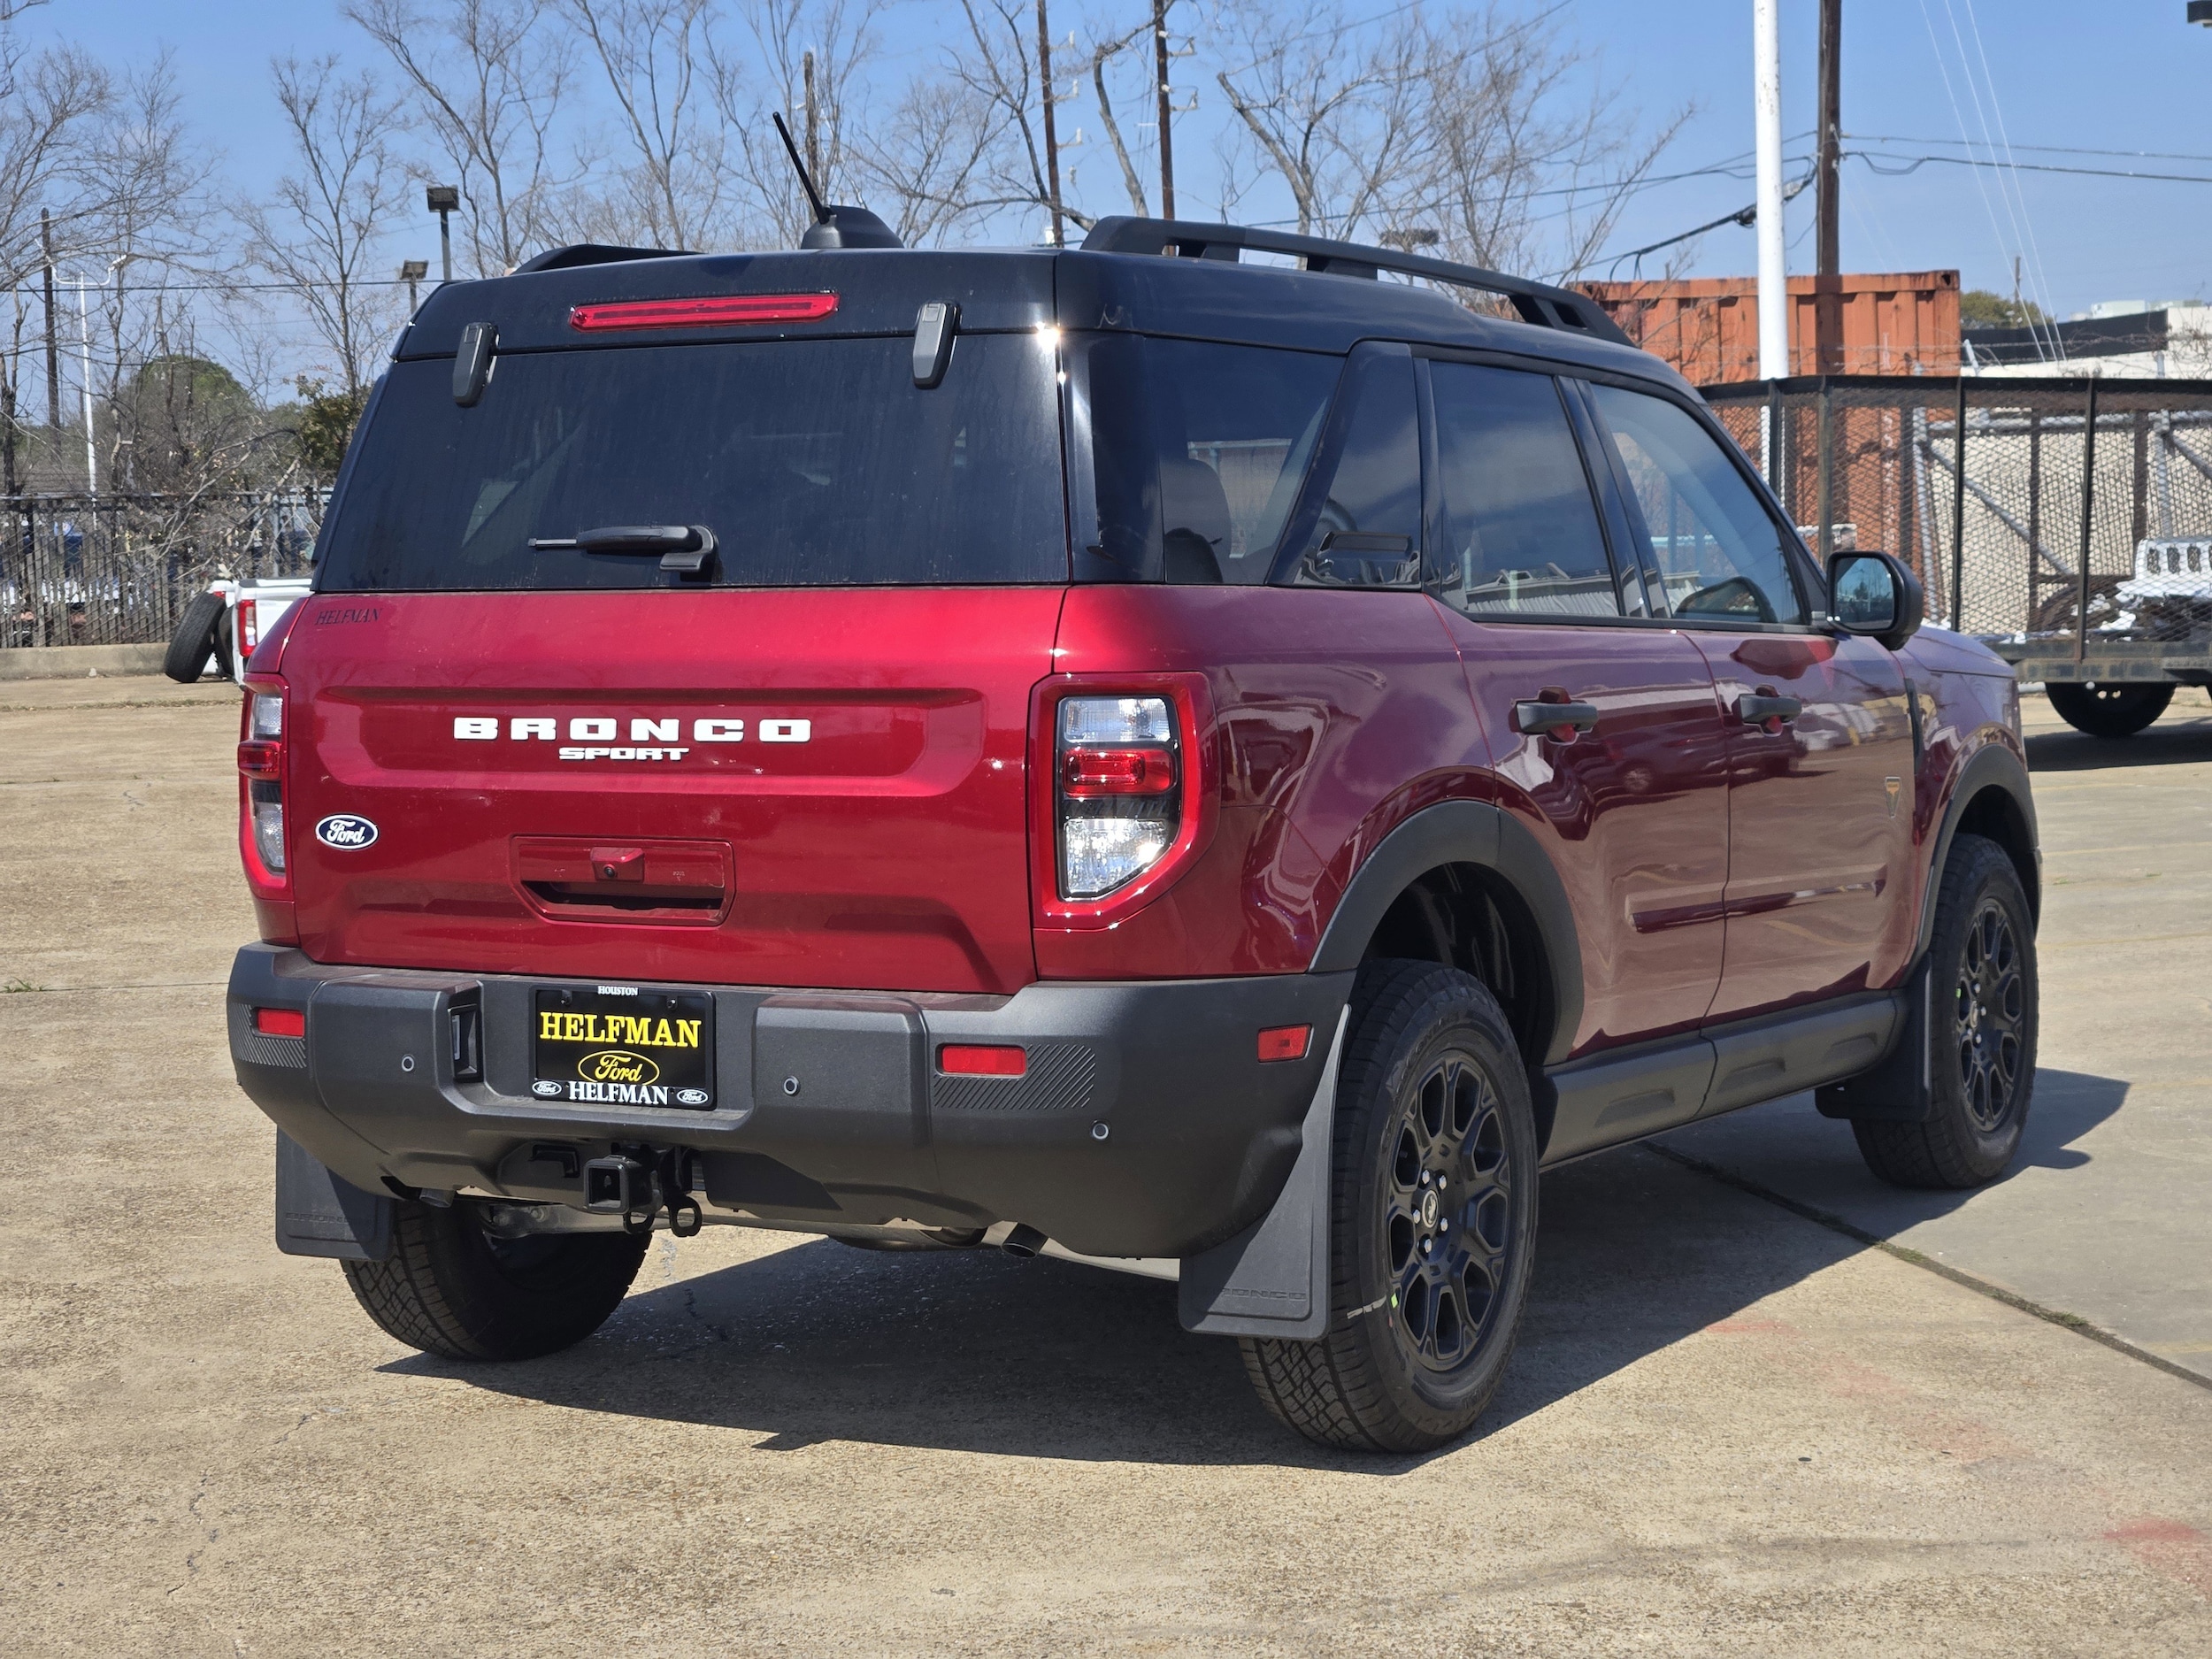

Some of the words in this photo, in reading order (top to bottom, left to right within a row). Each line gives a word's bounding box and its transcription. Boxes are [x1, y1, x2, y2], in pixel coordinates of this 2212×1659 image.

[314, 607, 384, 626] HELFMAN
[453, 717, 811, 742] BRONCO
[558, 746, 689, 761] SPORT
[326, 818, 366, 843] Ford
[597, 985, 639, 996] HOUSTON
[540, 1011, 702, 1048] HELFMAN
[595, 1054, 643, 1082] Ford
[568, 1080, 669, 1105] HELFMAN
[681, 1090, 704, 1102] Ford
